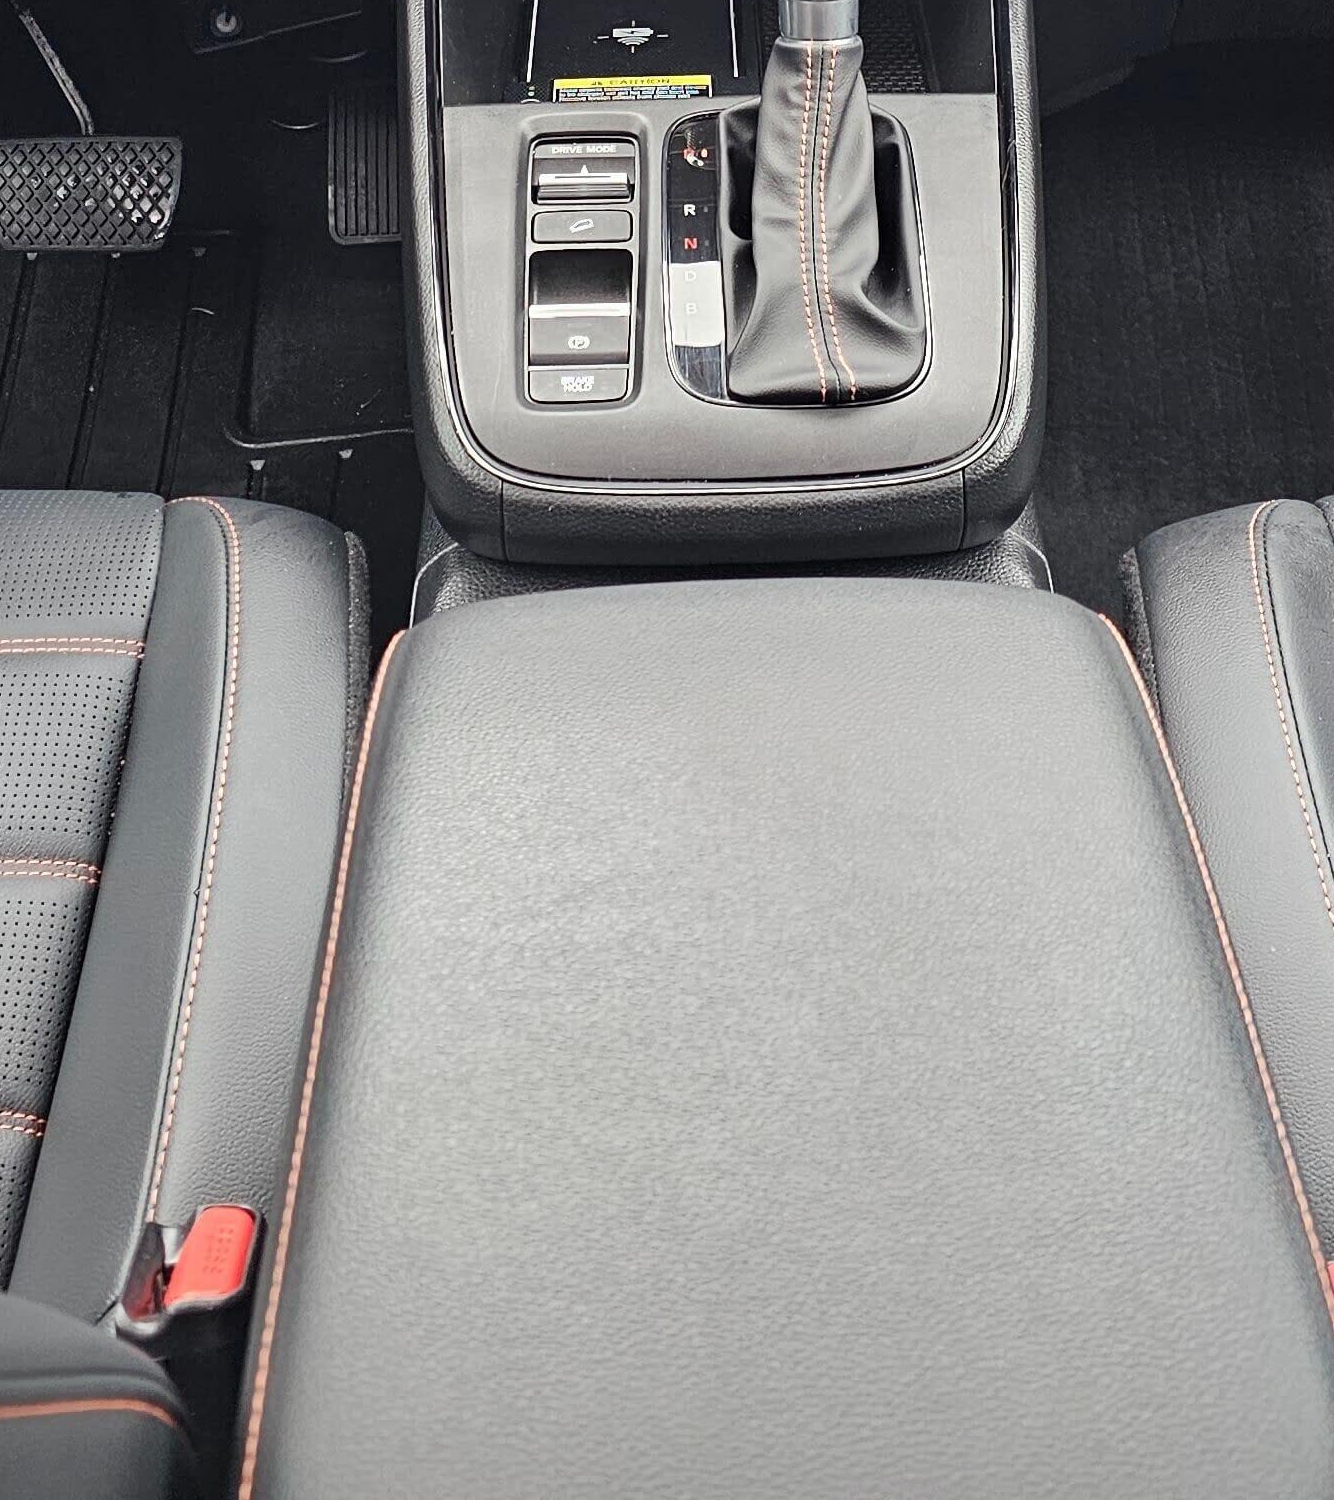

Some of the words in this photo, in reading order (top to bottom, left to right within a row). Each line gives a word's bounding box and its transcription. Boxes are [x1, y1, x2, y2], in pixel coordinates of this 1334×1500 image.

[551, 146, 582, 154] DRIVE
[586, 145, 616, 153] MODE
[684, 204, 696, 216] R
[684, 237, 697, 249] N
[684, 270, 696, 281] D
[686, 303, 697, 314] B
